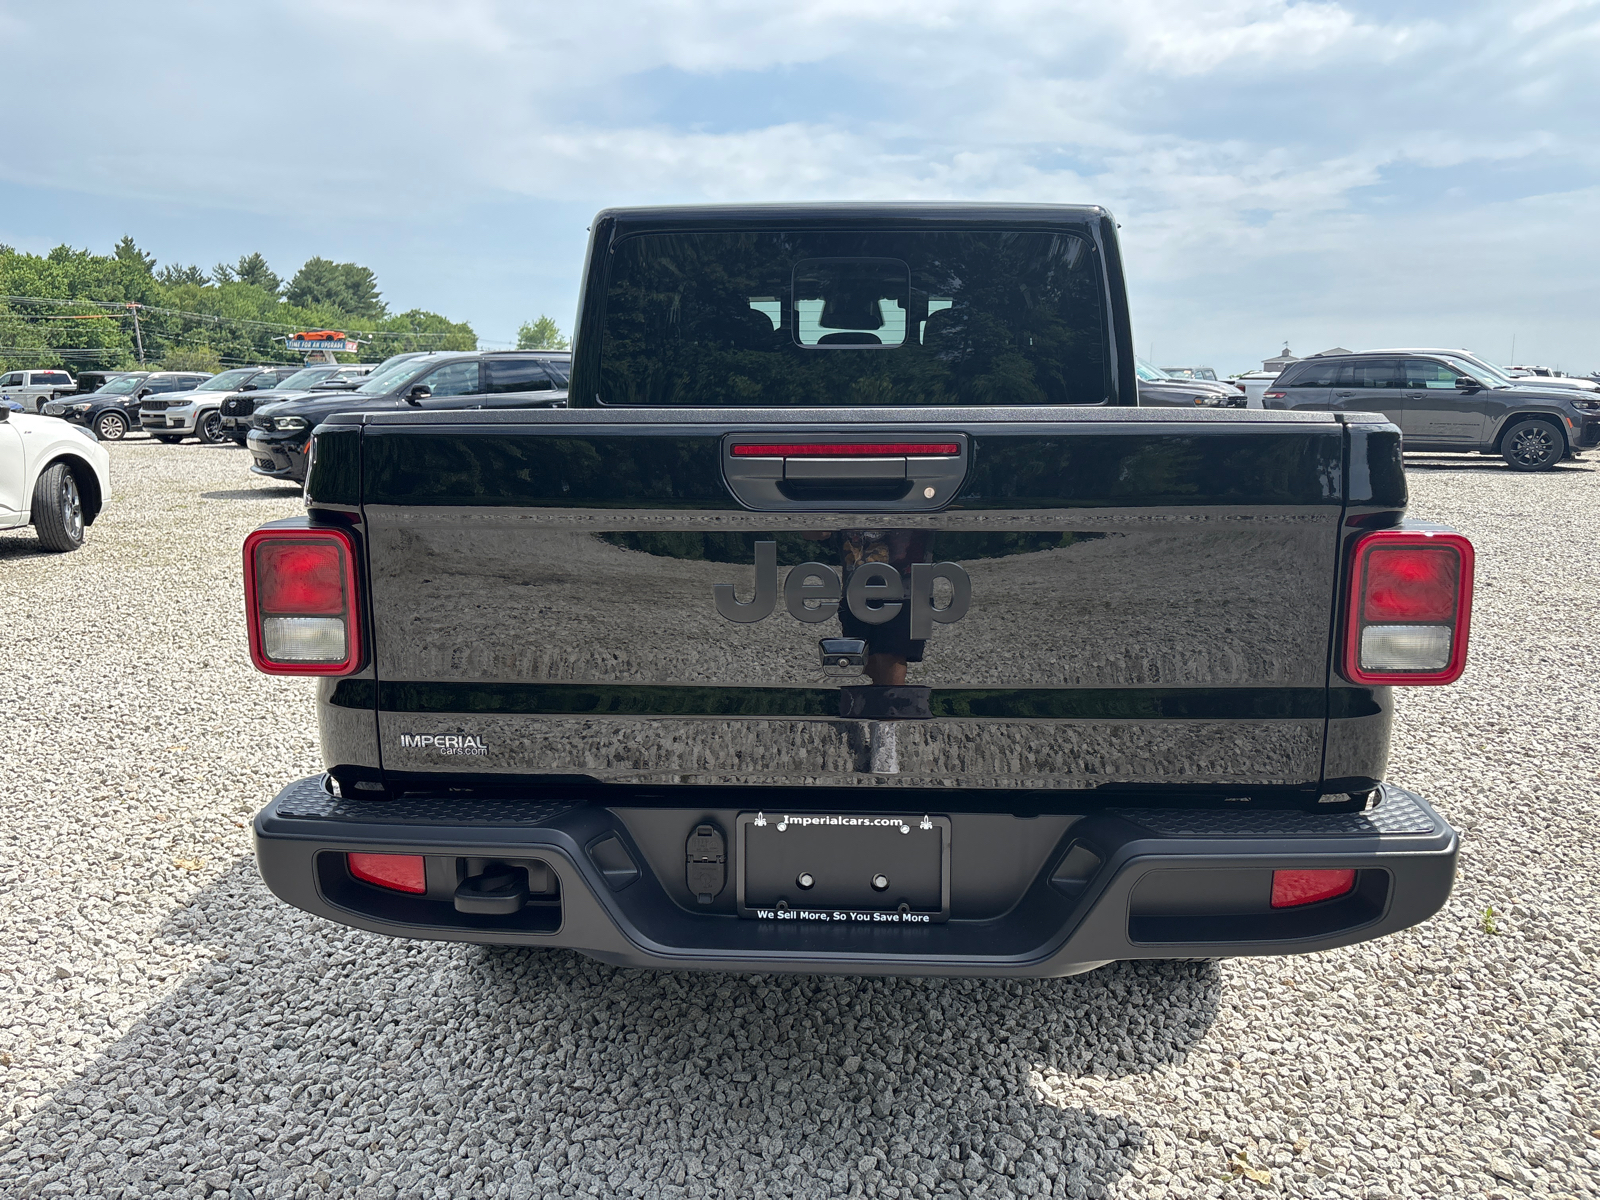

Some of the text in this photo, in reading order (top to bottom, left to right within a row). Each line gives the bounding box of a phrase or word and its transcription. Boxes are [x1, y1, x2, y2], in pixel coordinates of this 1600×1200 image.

[713, 540, 971, 640] Jeep
[400, 734, 488, 748] IMPERIAL
[440, 747, 488, 755] cars.com
[783, 815, 903, 827] Imperialcars.com
[757, 910, 930, 922] We Sell More, So You Save More
